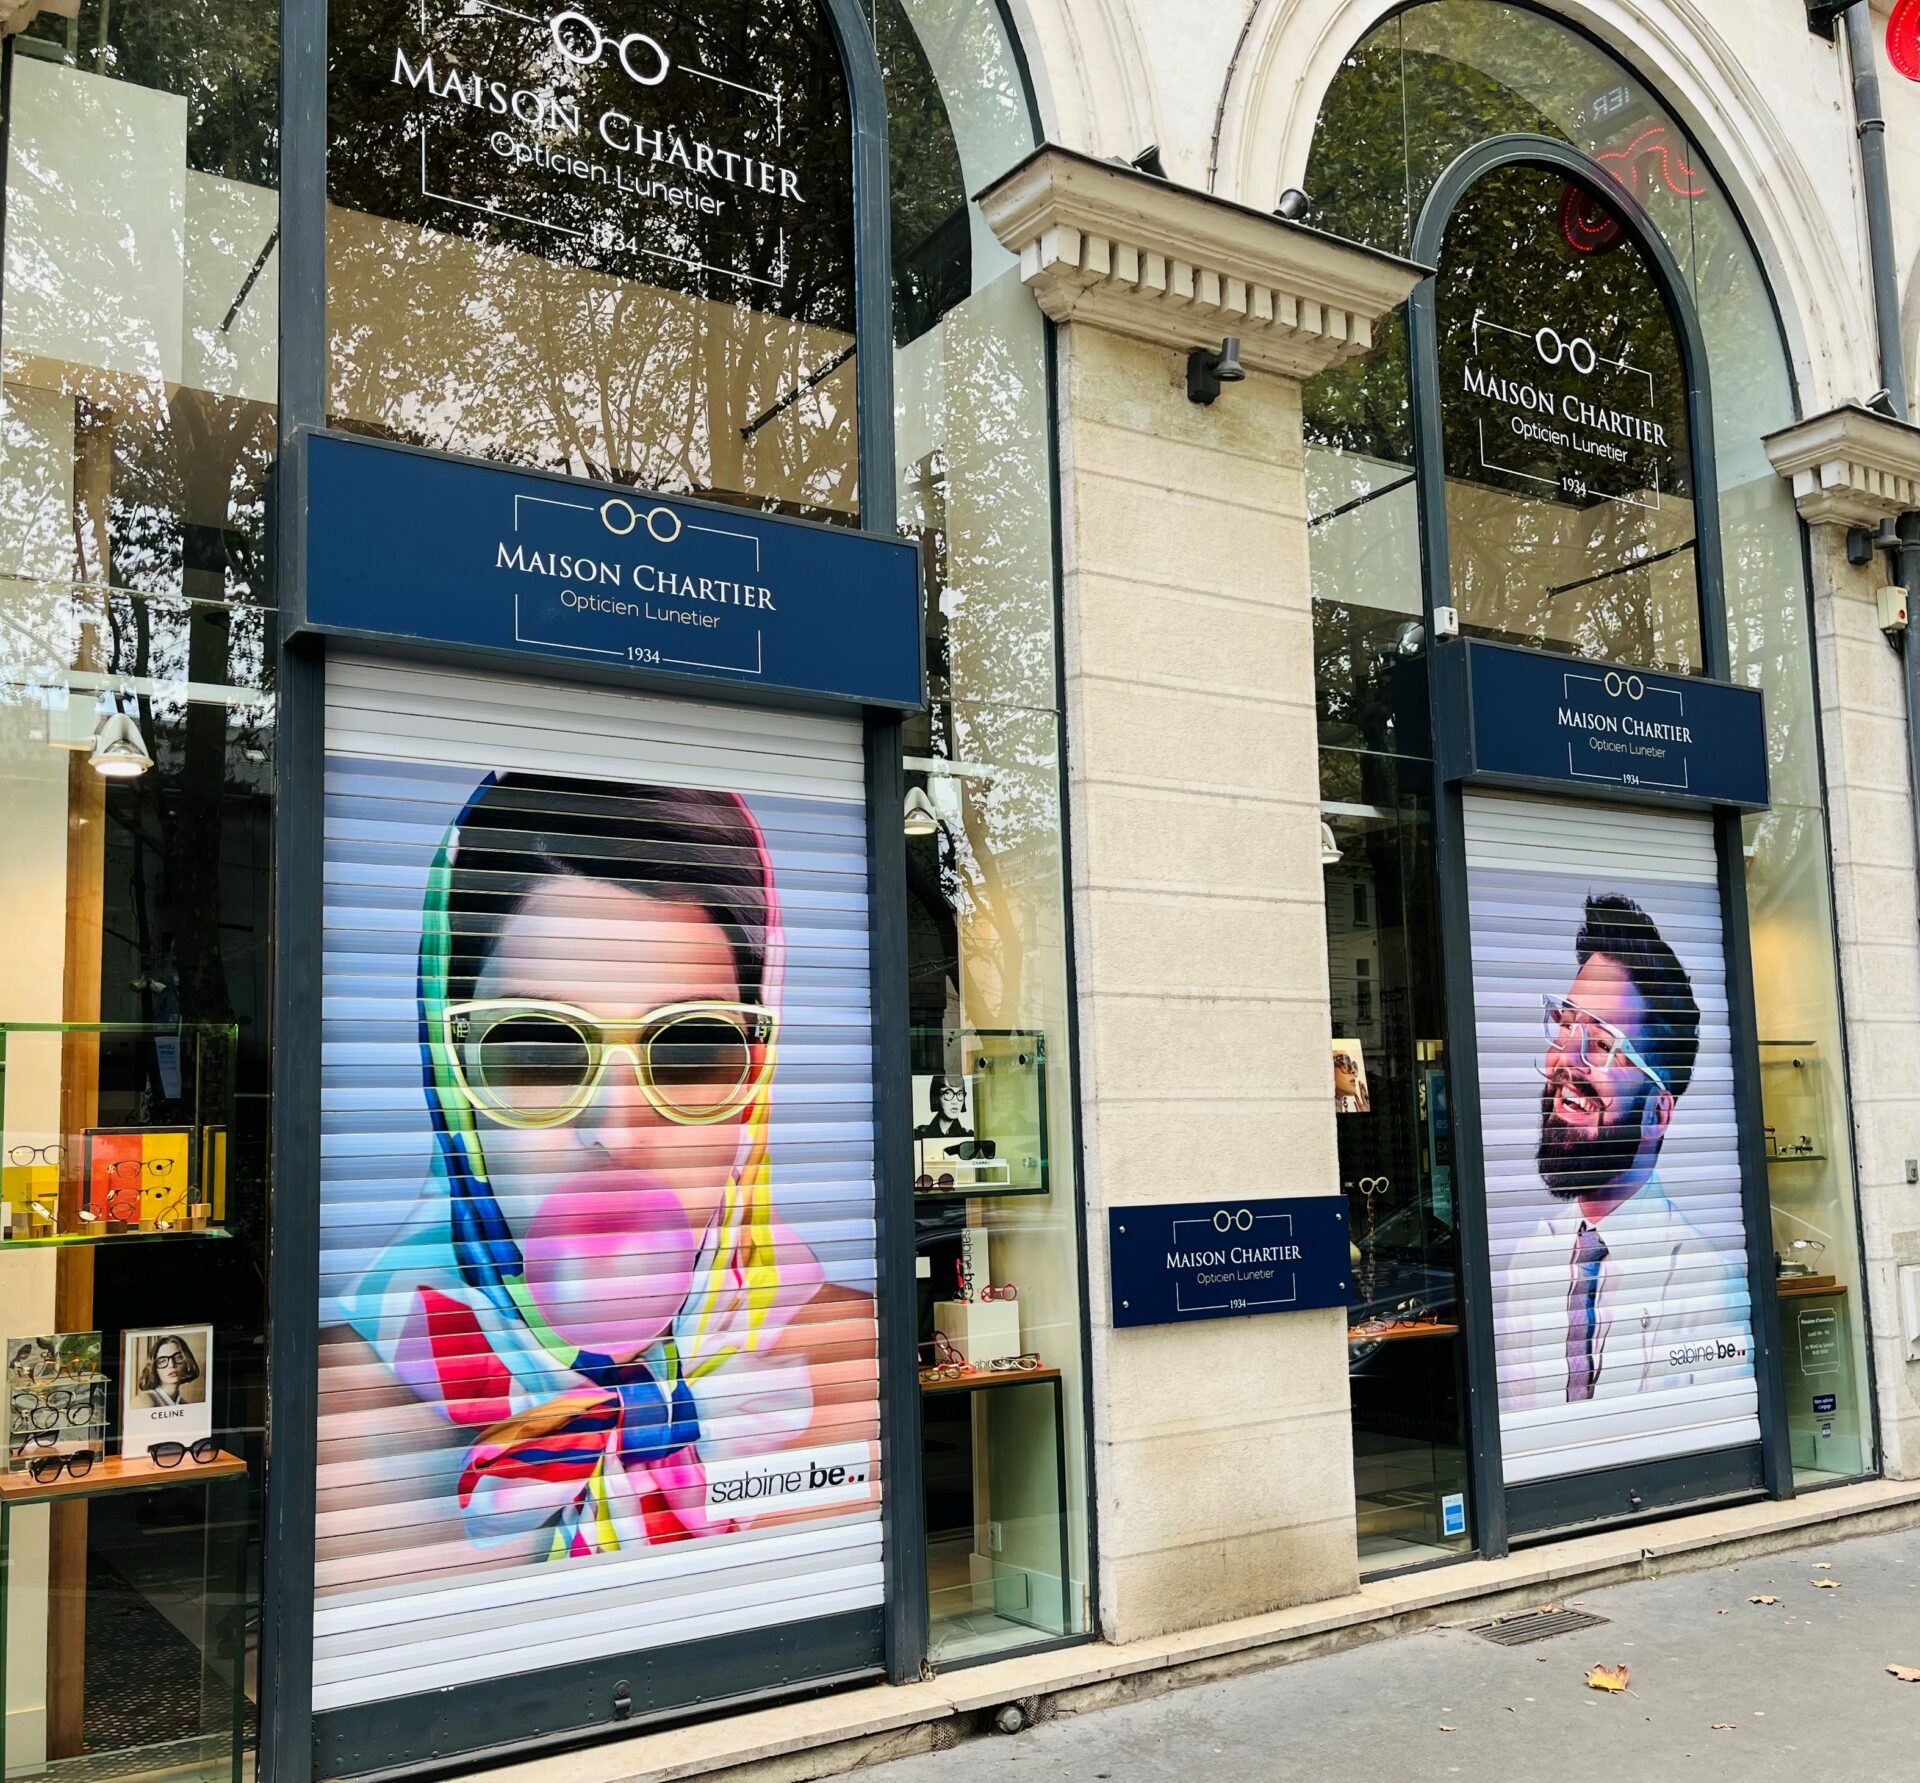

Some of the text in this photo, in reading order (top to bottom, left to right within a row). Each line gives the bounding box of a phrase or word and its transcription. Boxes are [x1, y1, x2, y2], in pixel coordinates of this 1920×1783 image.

[391, 48, 806, 203] MAISON CHARTIER
[490, 131, 726, 216] Opticien Lunetier
[591, 228, 638, 255] 1934
[1463, 365, 1668, 447] MAISON CHARTIER
[1511, 416, 1628, 463] Opticien Lunetier
[1562, 476, 1586, 495] 1934
[495, 542, 776, 611] MAISON CHARTIER
[560, 589, 720, 628] Opticien Lunetier
[627, 647, 660, 664] 1934
[1558, 707, 1692, 744] MAISON CHARTIER
[1589, 736, 1666, 759] Opticien Lunetier
[1622, 773, 1639, 785] 1934
[1166, 1245, 1302, 1269] MAISON CHARTIER
[1197, 1269, 1275, 1286] Opticien Lunetier
[1230, 1299, 1246, 1309] 1934
[1669, 1343, 1714, 1366] sabine
[150, 1409, 184, 1420] CELINE
[711, 1467, 801, 1503] sabine
